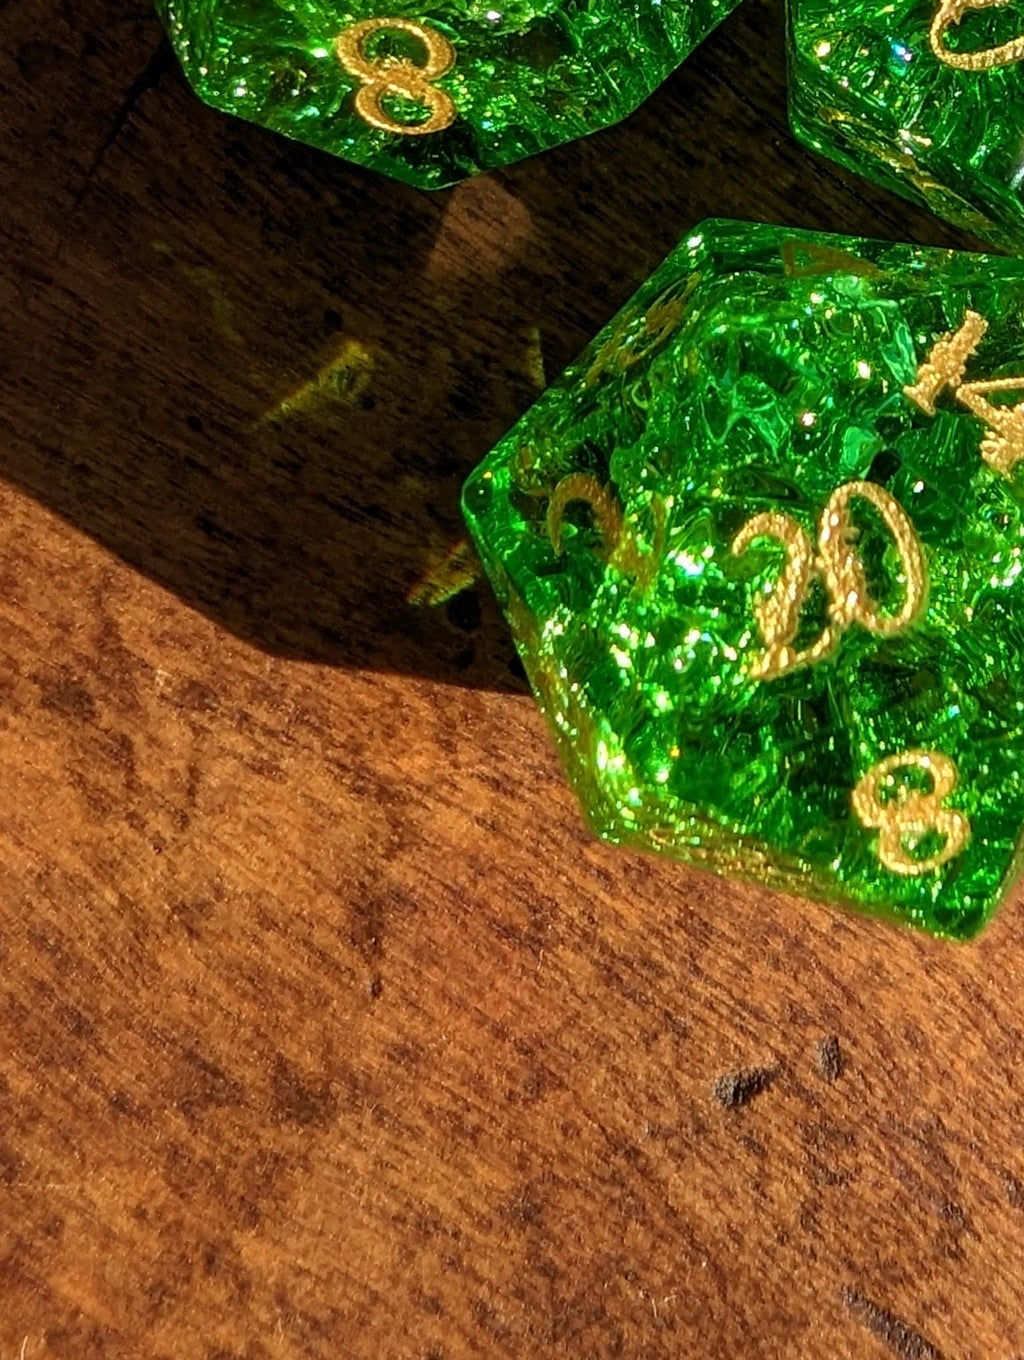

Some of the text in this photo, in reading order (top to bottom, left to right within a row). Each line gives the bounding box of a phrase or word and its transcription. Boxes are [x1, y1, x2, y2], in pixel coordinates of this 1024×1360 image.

[334, 17, 456, 135] 8
[730, 481, 926, 681] 20
[851, 748, 971, 876] 8
